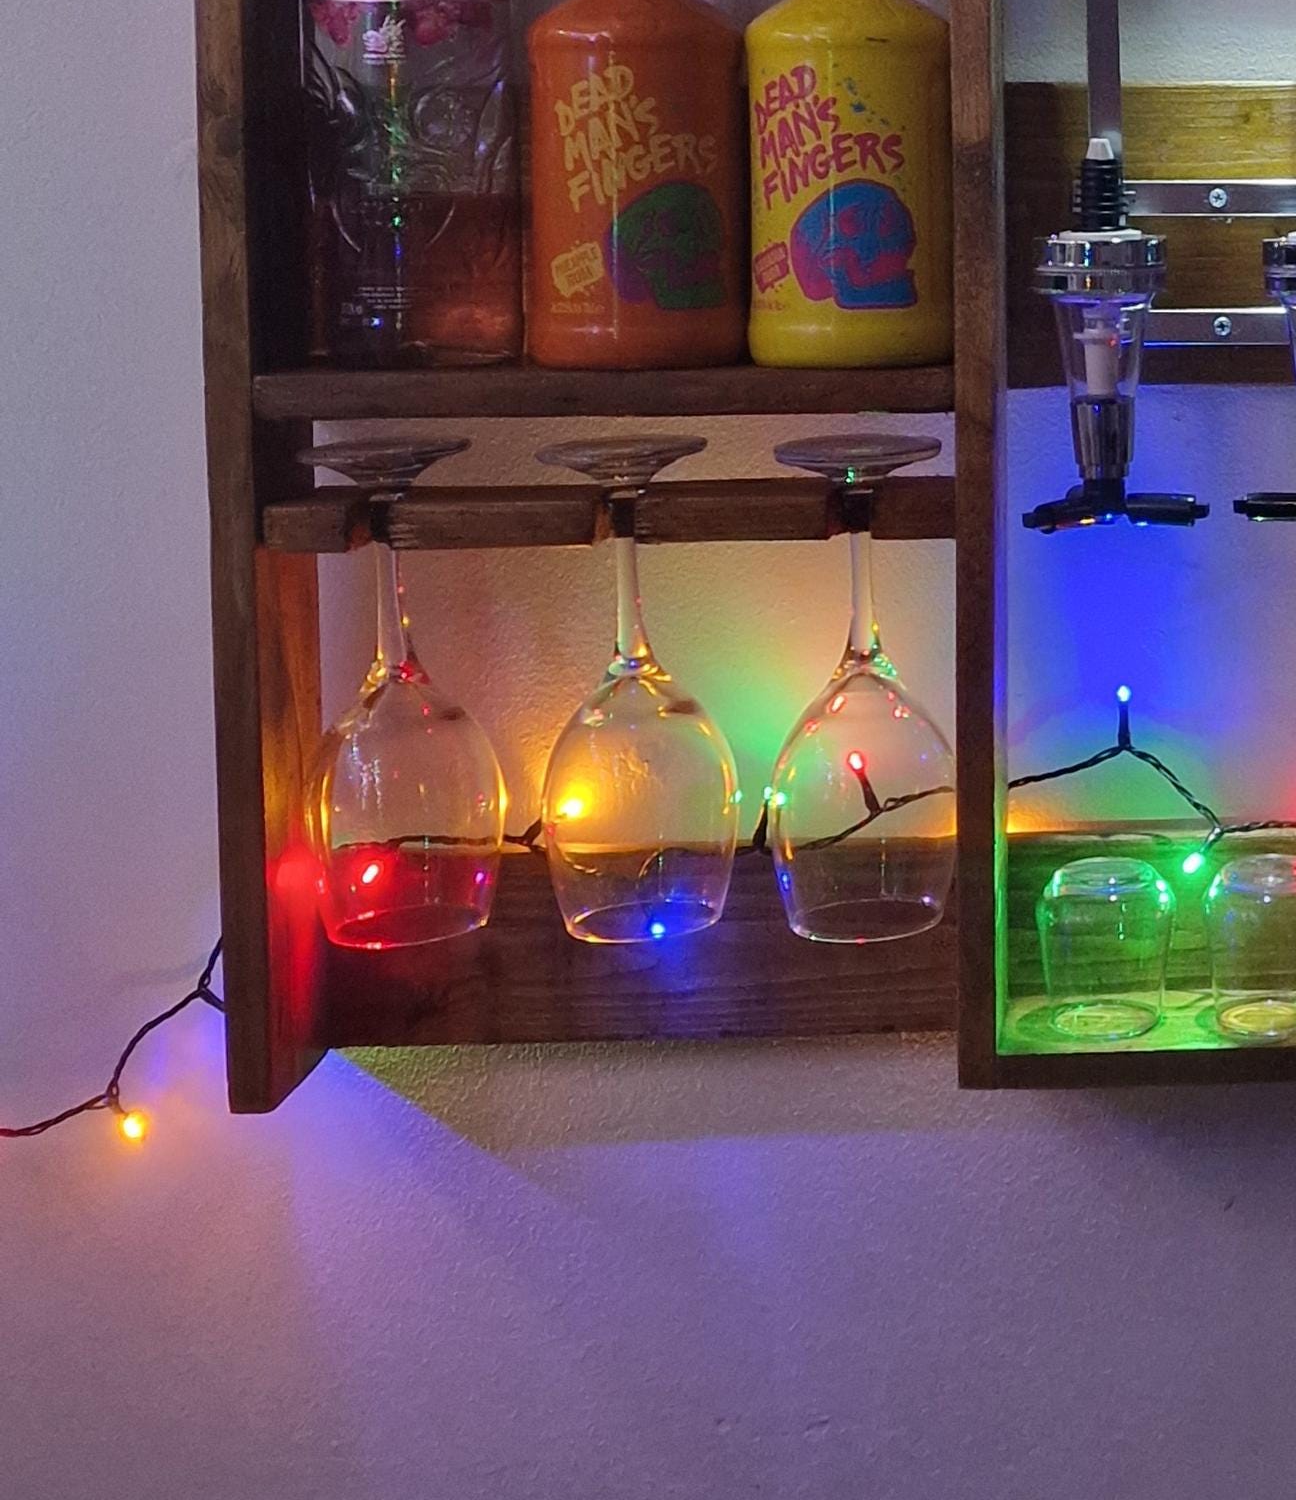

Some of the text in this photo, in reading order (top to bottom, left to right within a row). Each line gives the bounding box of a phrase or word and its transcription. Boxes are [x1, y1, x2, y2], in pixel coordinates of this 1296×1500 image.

[554, 65, 634, 137] DEAD
[564, 95, 657, 173] MAN'S
[755, 65, 817, 135] DEAD
[760, 95, 840, 170] MAN'S
[567, 132, 719, 214] FINGERS
[763, 132, 905, 211] FINGERS
